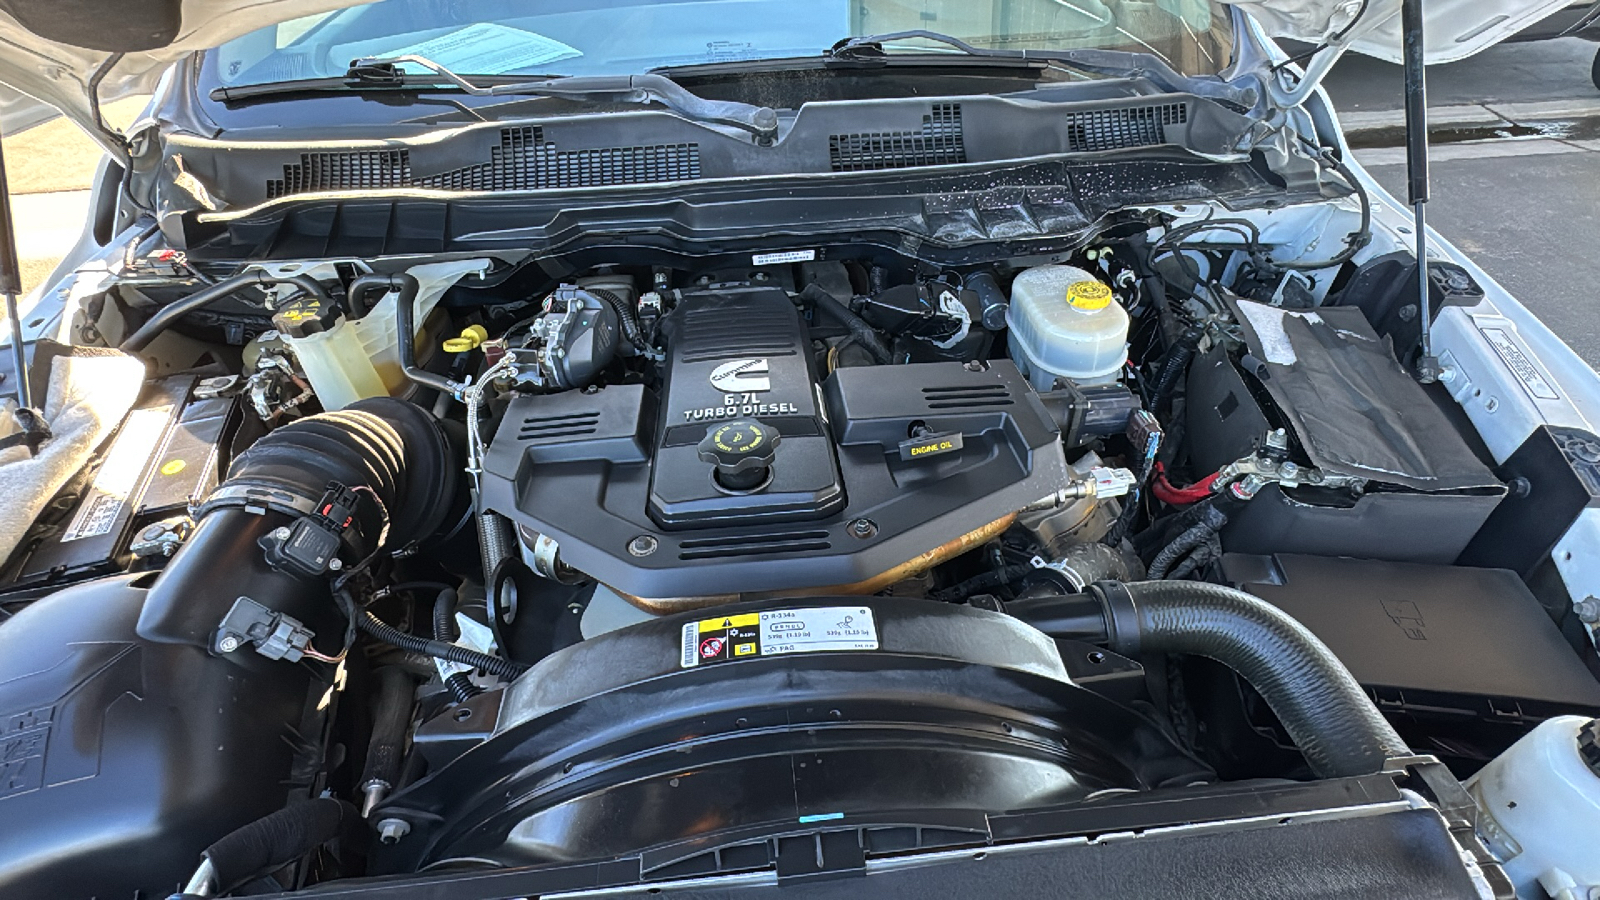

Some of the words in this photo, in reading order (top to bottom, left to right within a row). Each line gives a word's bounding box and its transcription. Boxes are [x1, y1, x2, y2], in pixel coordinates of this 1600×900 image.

[711, 359, 763, 381] Cummins
[724, 392, 761, 406] 6.7L
[683, 406, 738, 420] TURBO
[742, 402, 798, 415] DIESEL
[911, 443, 939, 456] ENGINE
[940, 441, 953, 450] OIL
